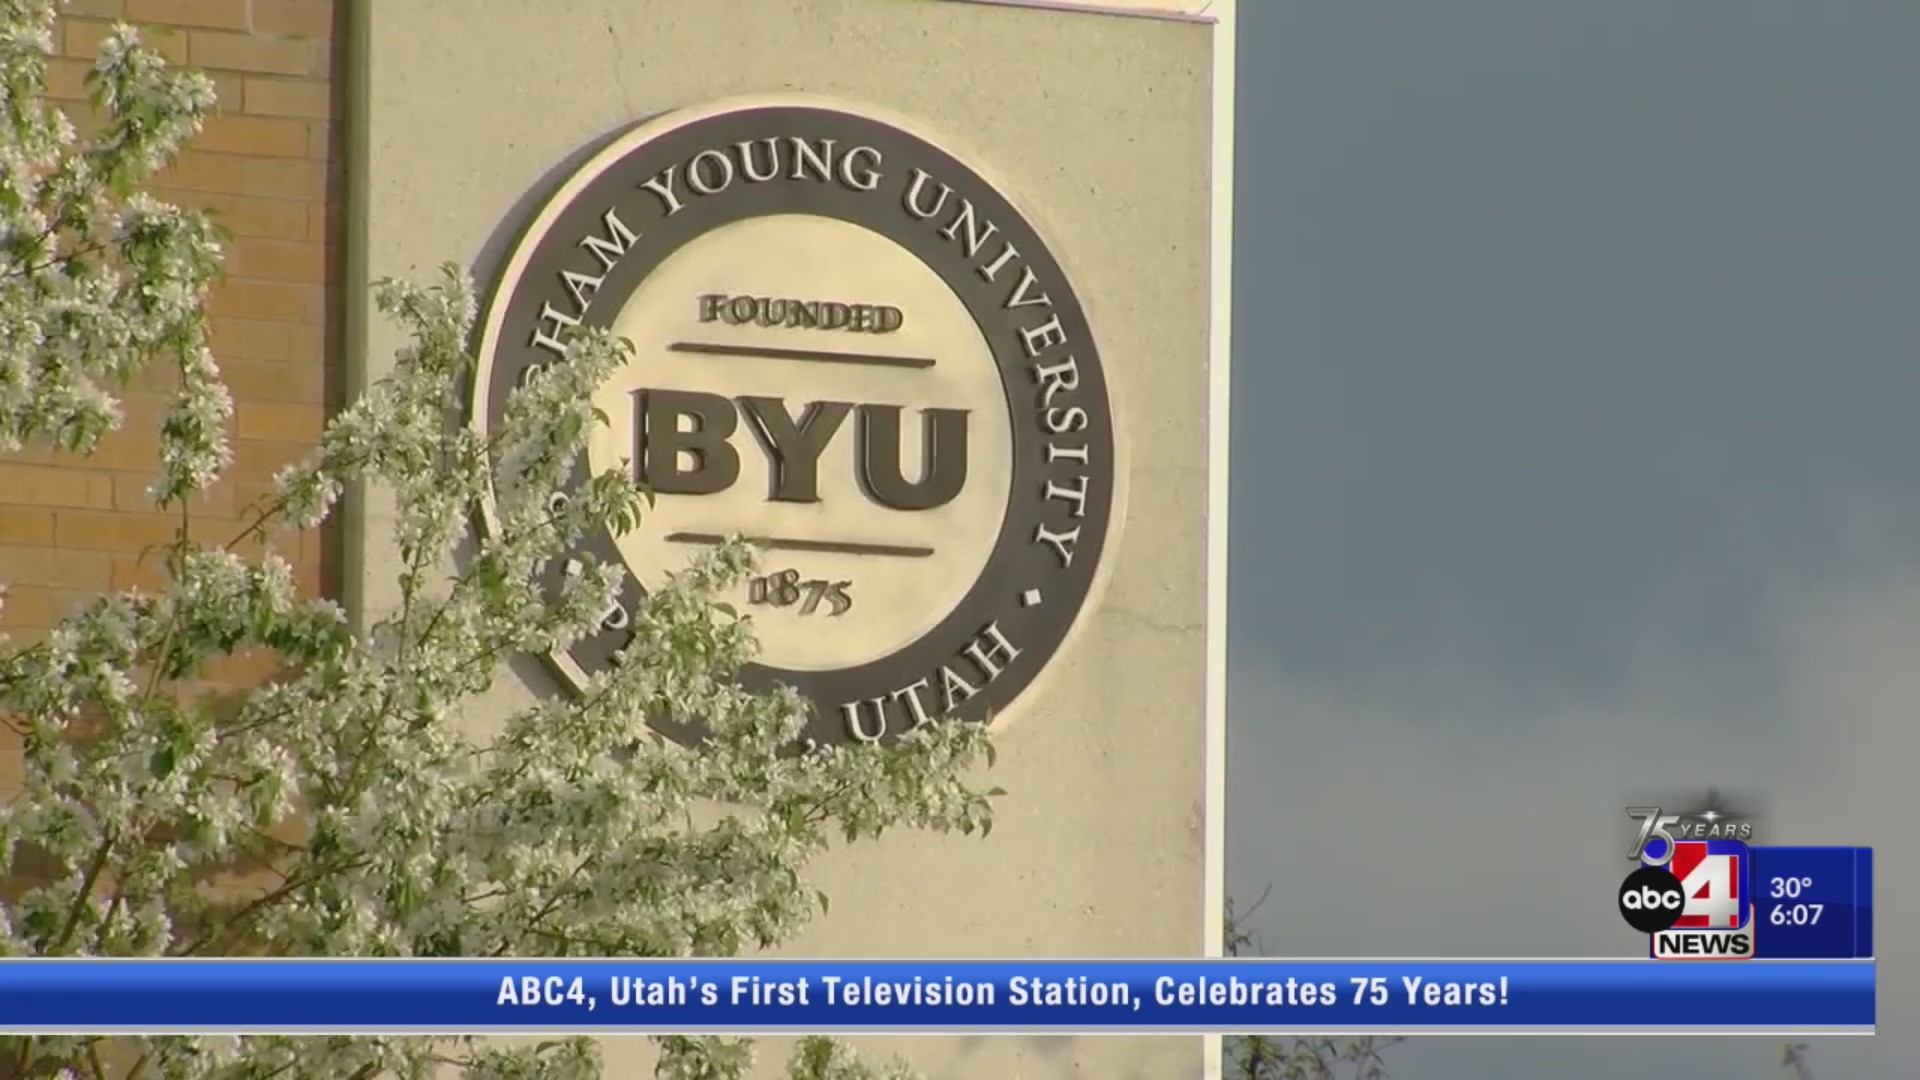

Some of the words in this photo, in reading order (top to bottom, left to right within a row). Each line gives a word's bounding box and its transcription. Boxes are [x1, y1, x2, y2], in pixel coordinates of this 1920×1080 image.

[641, 136, 884, 216] YOUNG
[903, 168, 1089, 568] UNIVERSITY
[697, 294, 904, 334] FOUNDED
[629, 388, 973, 511] BYU
[747, 568, 853, 617] 1875
[840, 620, 1023, 741] UTAH
